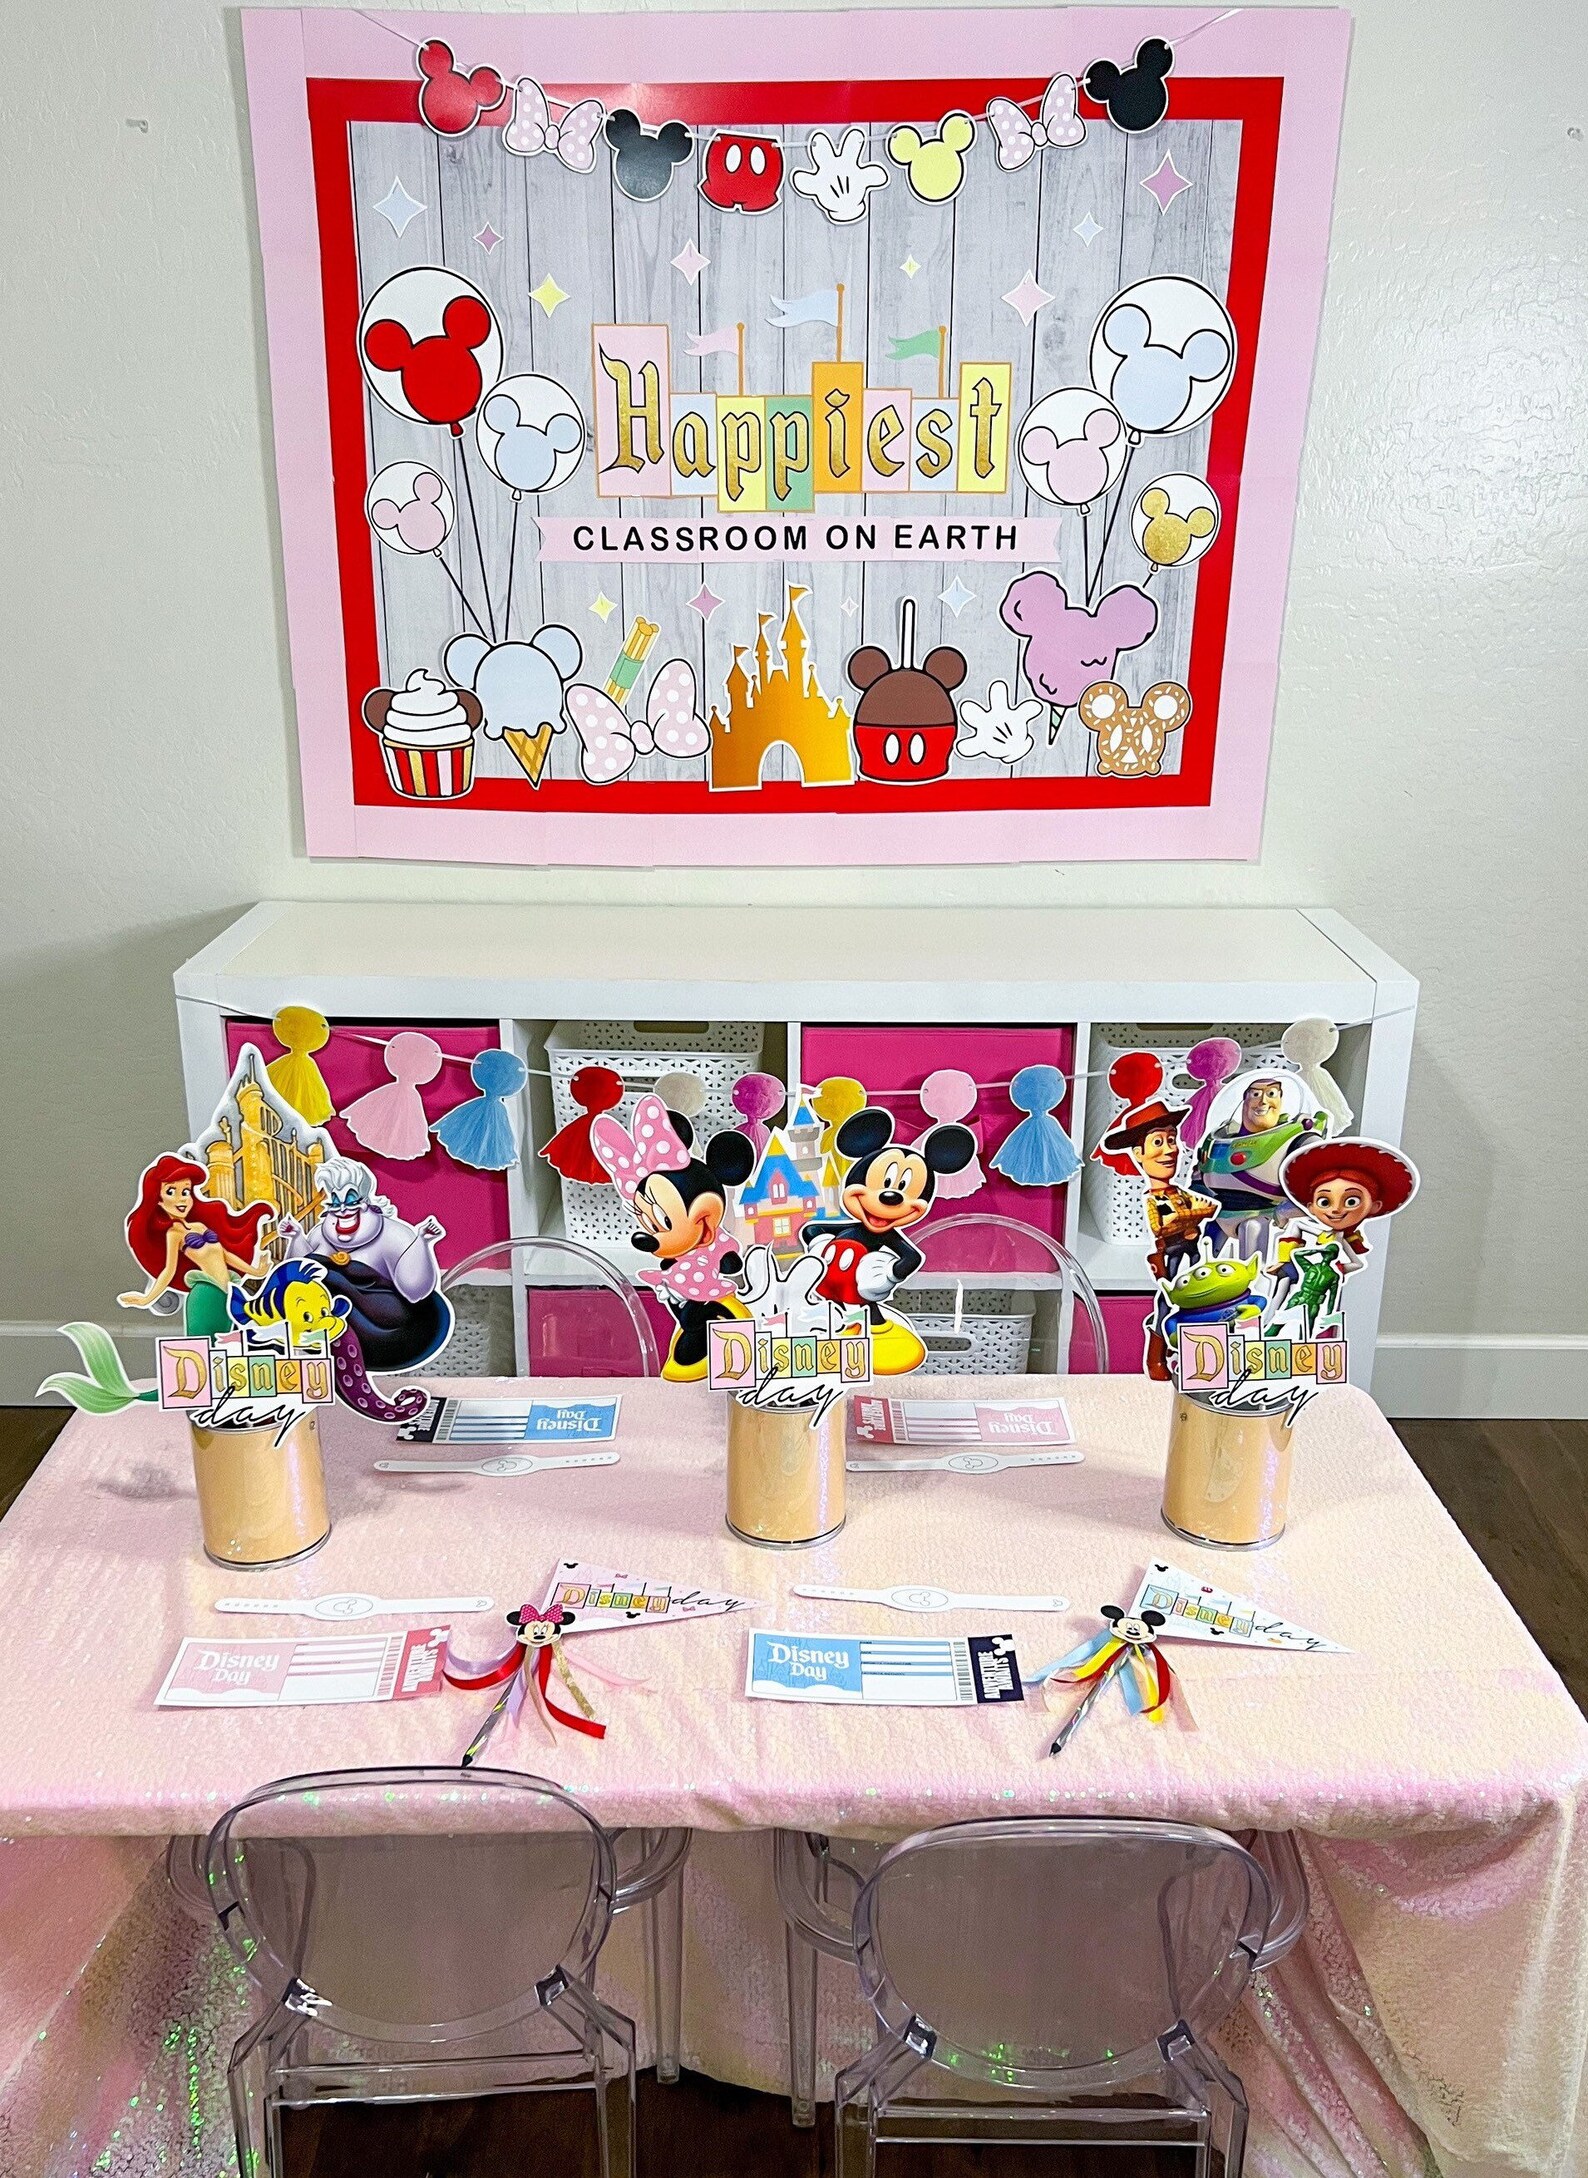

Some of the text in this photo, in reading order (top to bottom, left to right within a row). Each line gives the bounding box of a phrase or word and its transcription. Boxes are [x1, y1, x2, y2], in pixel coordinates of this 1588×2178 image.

[598, 343, 1002, 501] Happiest
[573, 523, 1017, 552] CLASSROOM ON EARTH
[712, 1328, 866, 1381] Disney
[1183, 1331, 1343, 1382] Disney
[163, 1346, 328, 1399] Disney
[738, 1366, 843, 1427] day
[1211, 1369, 1319, 1426] day
[195, 1385, 305, 1447] day
[536, 1417, 602, 1432] Disney
[557, 1409, 586, 1421] Day
[989, 1421, 1058, 1435] Disney
[1004, 1412, 1033, 1423] Day
[557, 1585, 746, 1611] Disney day
[1145, 1588, 1327, 1650] Disney day
[193, 1650, 280, 1672] Disney
[767, 1641, 849, 1669] Disney
[212, 1669, 250, 1684] Day
[789, 1662, 828, 1680] Day
[978, 1650, 1001, 1699] ADVENTURE
[994, 1657, 1014, 1690] AWAITS
